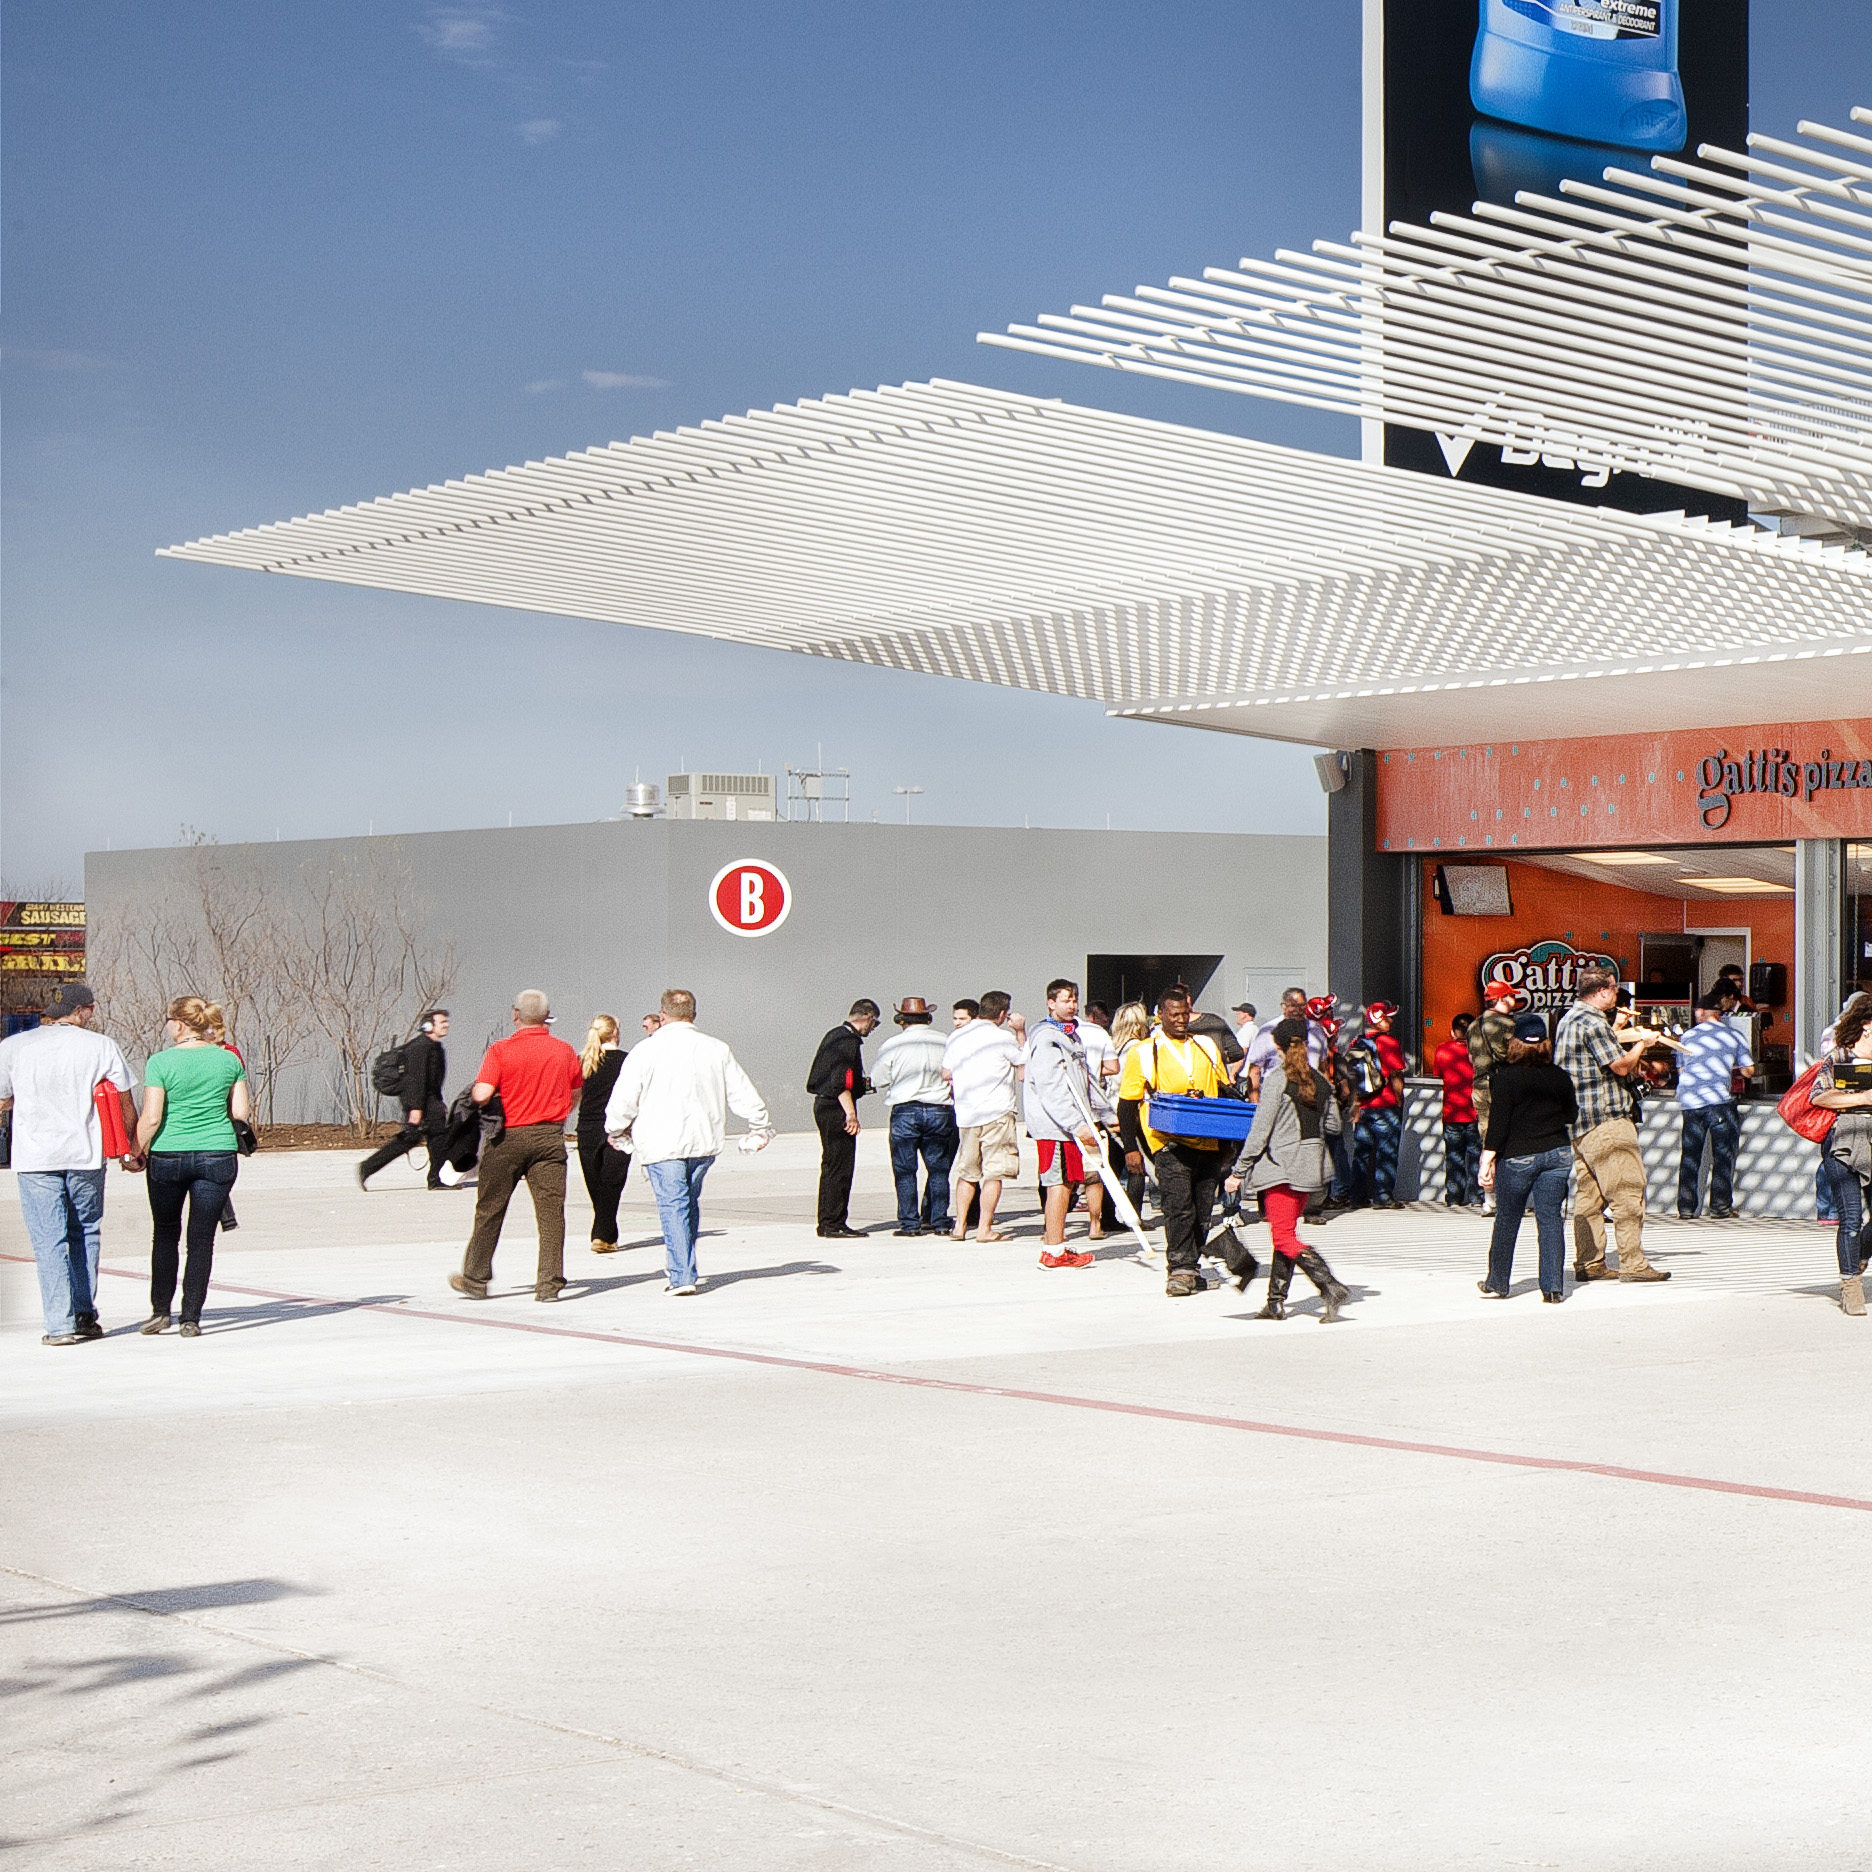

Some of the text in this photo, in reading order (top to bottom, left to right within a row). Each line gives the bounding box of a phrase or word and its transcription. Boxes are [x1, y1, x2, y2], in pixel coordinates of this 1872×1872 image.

[1618, 14, 1656, 31] DEODORANT
[1696, 748, 1798, 830] gatti's
[740, 872, 765, 923] B
